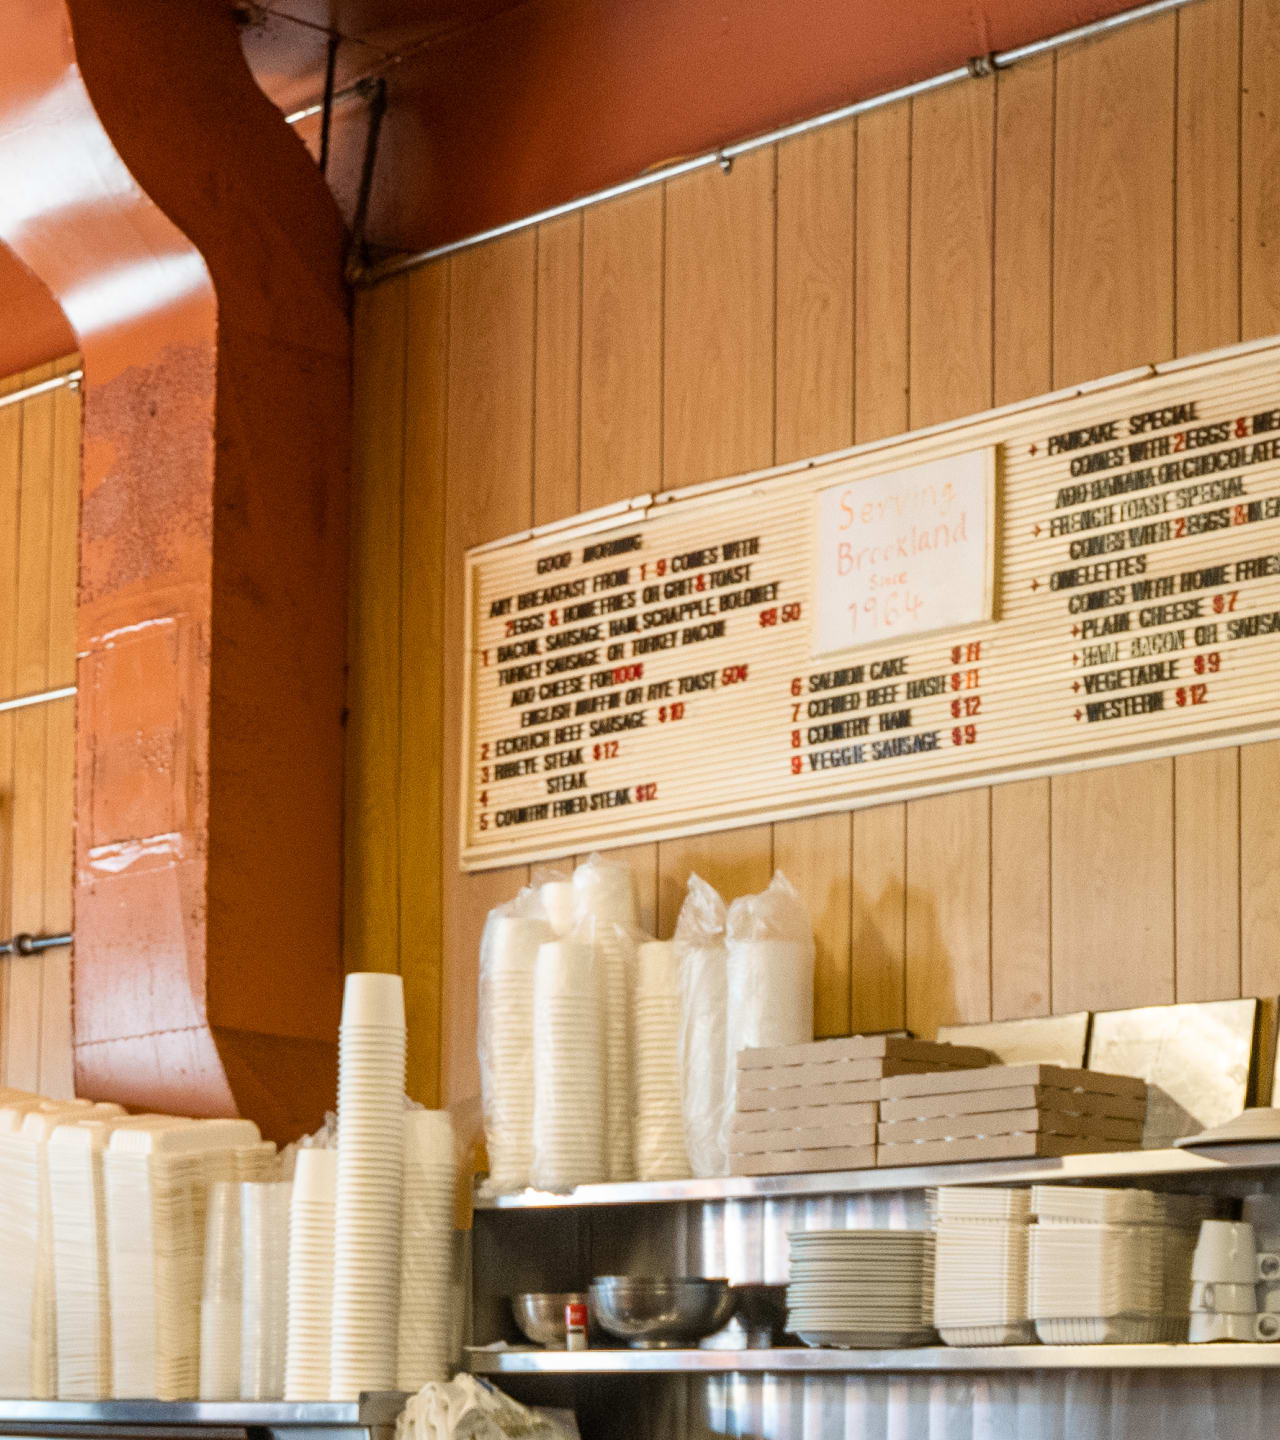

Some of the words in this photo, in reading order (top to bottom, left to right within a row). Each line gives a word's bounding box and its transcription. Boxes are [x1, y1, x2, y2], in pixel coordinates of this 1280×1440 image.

[1130, 400, 1201, 435] SPECIAL
[1082, 611, 1130, 639] PLAIN
[1140, 597, 1206, 628] CHEESE
[870, 656, 909, 681] CAKE
[1084, 659, 1181, 695] VEGETABLE
[867, 684, 899, 707] BEEF
[808, 743, 866, 771] VEGGIE
[872, 730, 942, 760] SAUSAGE
[547, 771, 588, 794] STEAK
